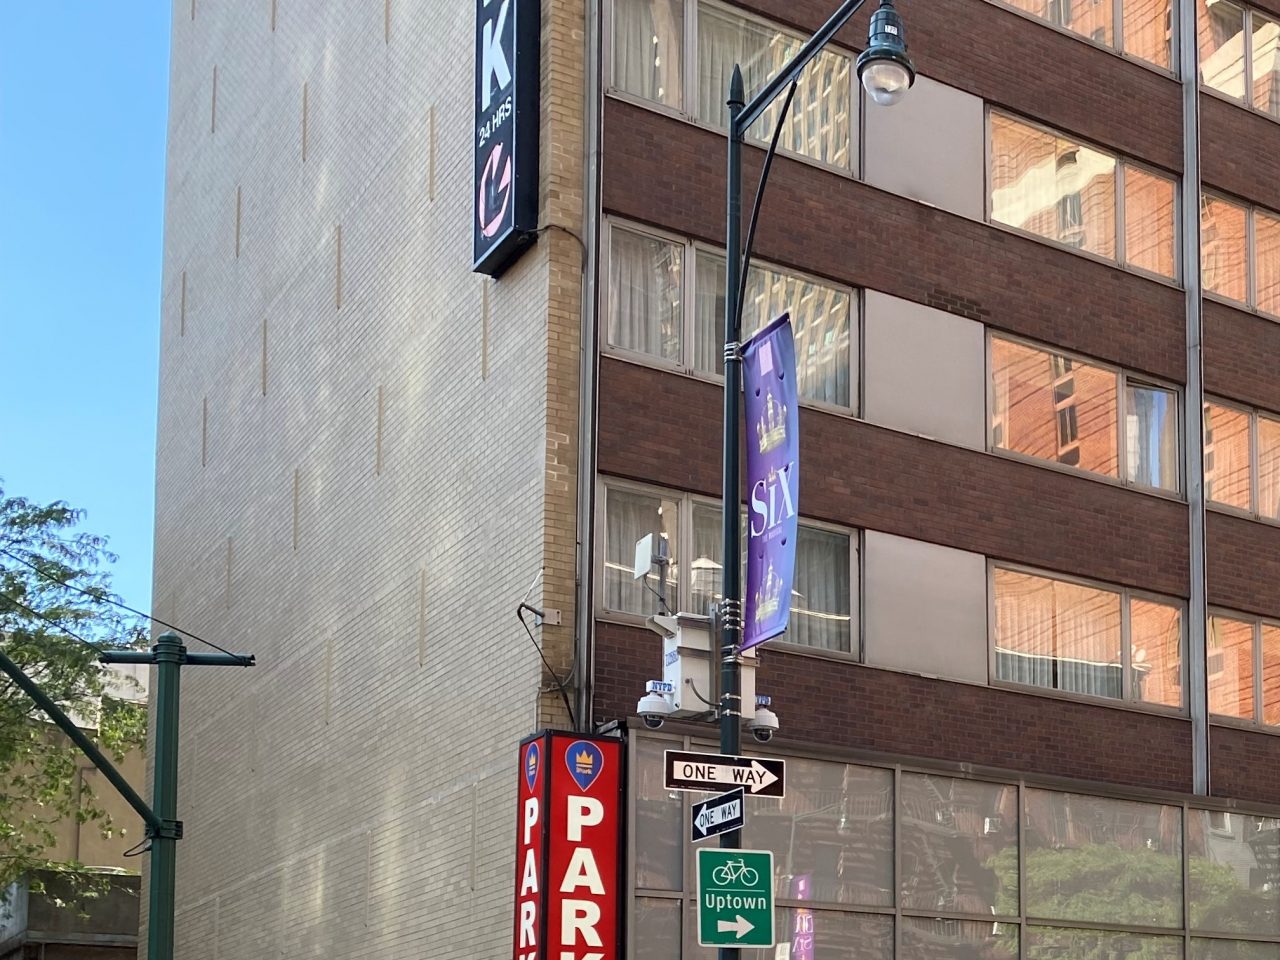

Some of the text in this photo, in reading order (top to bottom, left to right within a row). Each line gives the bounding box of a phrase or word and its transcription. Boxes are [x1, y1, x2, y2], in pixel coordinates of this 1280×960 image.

[482, 0, 512, 112] K
[479, 96, 512, 148] 24 HRS
[652, 681, 673, 693] NYPD
[683, 764, 767, 784] ONE WAY
[700, 810, 715, 828] ONE
[720, 802, 737, 821] WAY
[705, 893, 767, 912] Uptown
